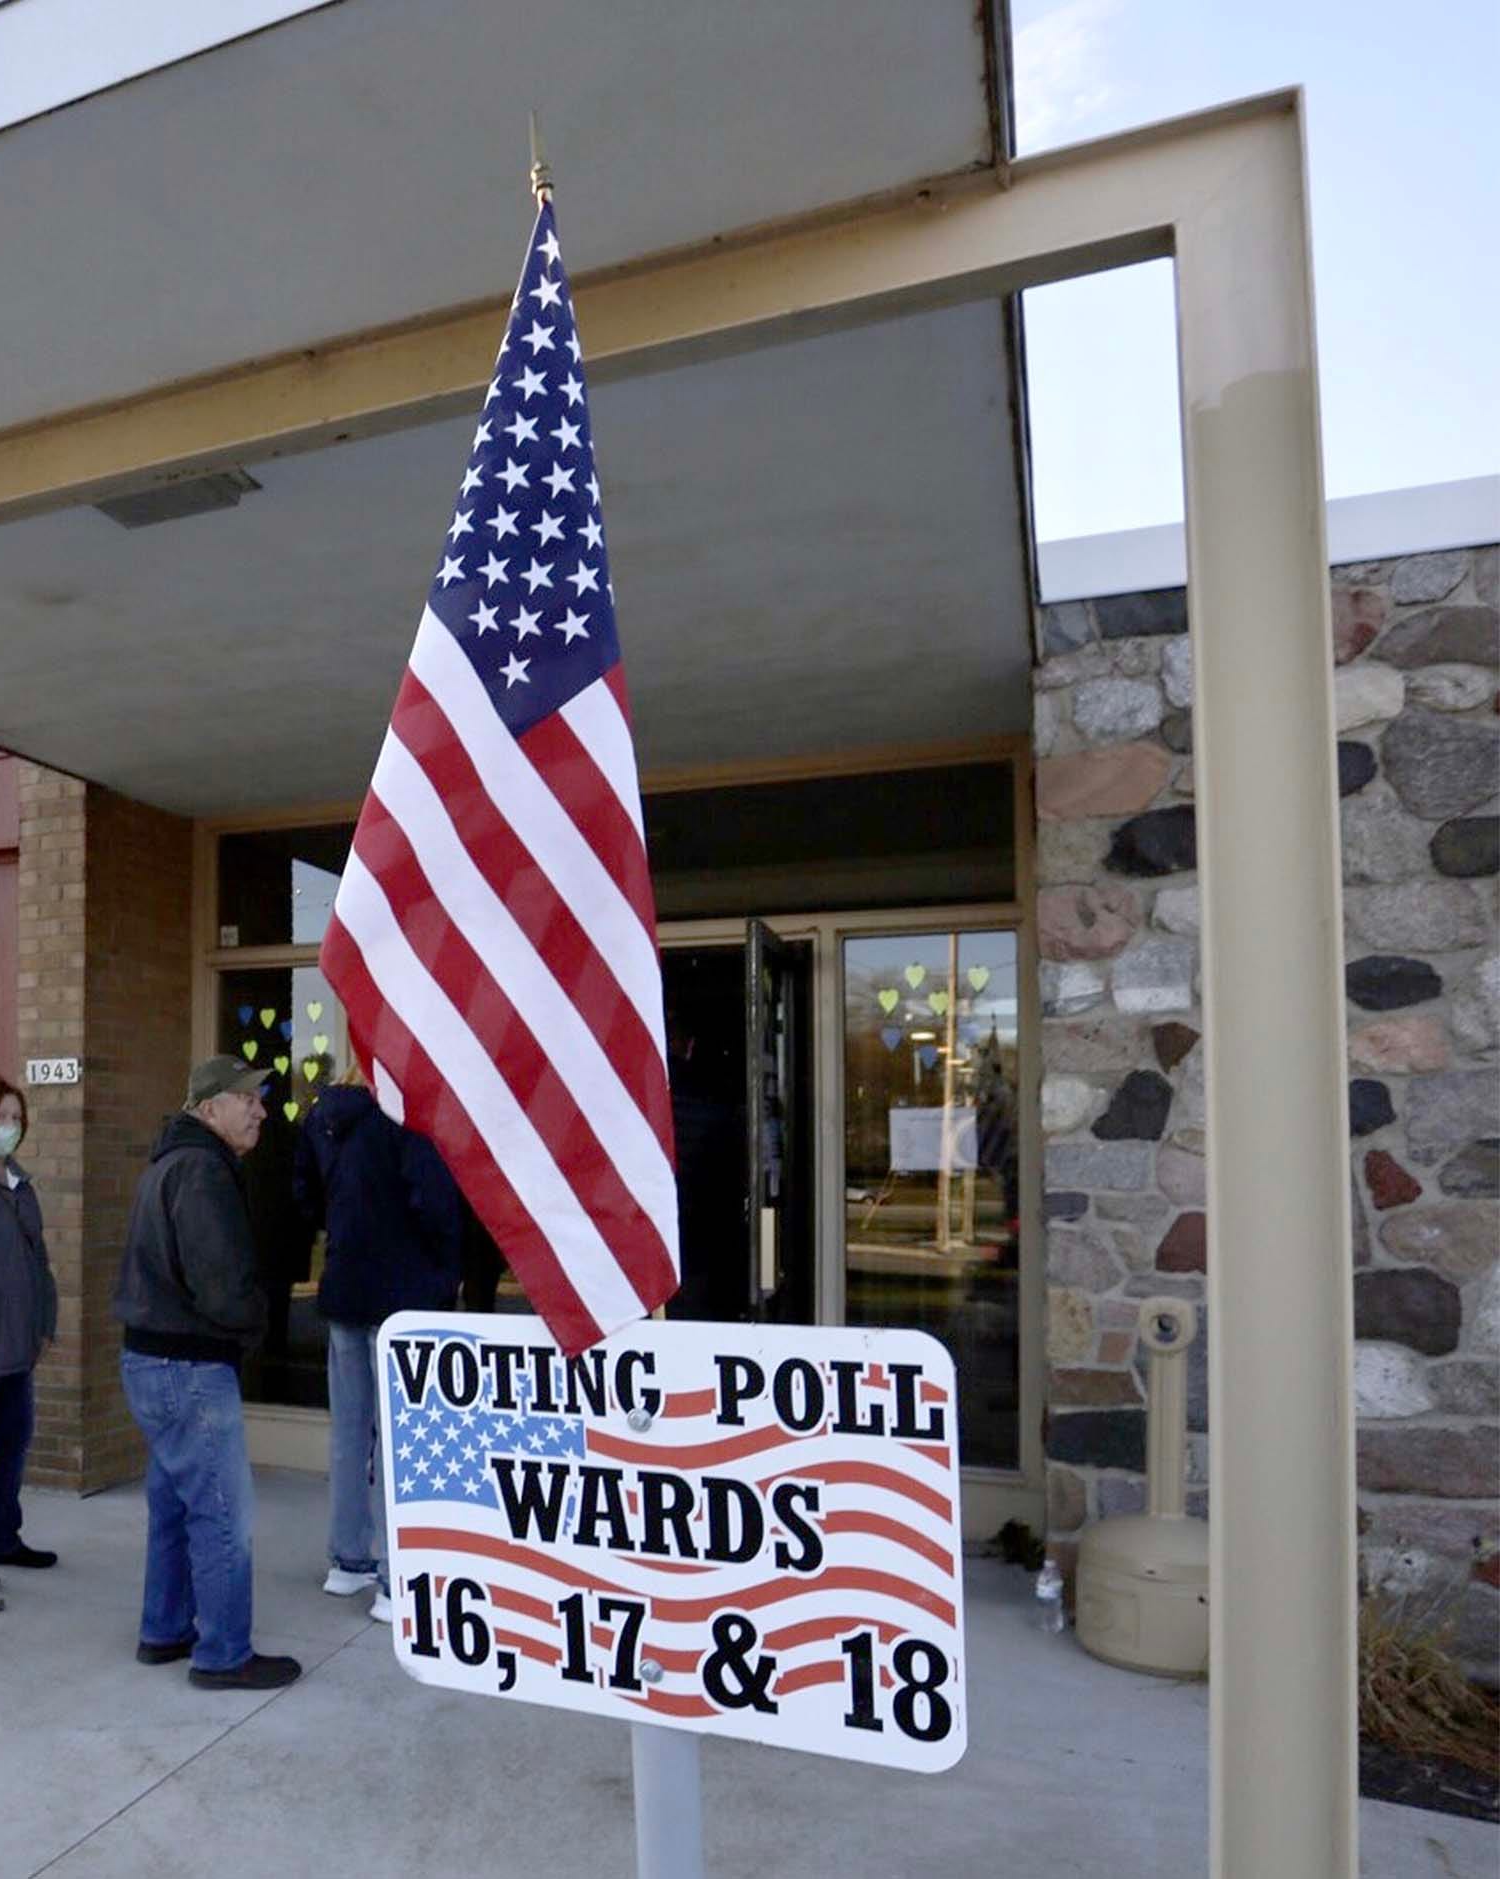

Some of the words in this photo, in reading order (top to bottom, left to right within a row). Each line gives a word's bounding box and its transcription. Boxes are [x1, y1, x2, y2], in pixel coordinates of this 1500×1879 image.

[30, 1062, 76, 1082] 1943
[389, 1339, 662, 1419] VOTING
[714, 1355, 946, 1440] POLL
[491, 1458, 825, 1573] WARDS
[407, 1572, 517, 1692] 16,
[558, 1593, 646, 1692] 17
[702, 1613, 779, 1715] &
[841, 1632, 953, 1743] 18
